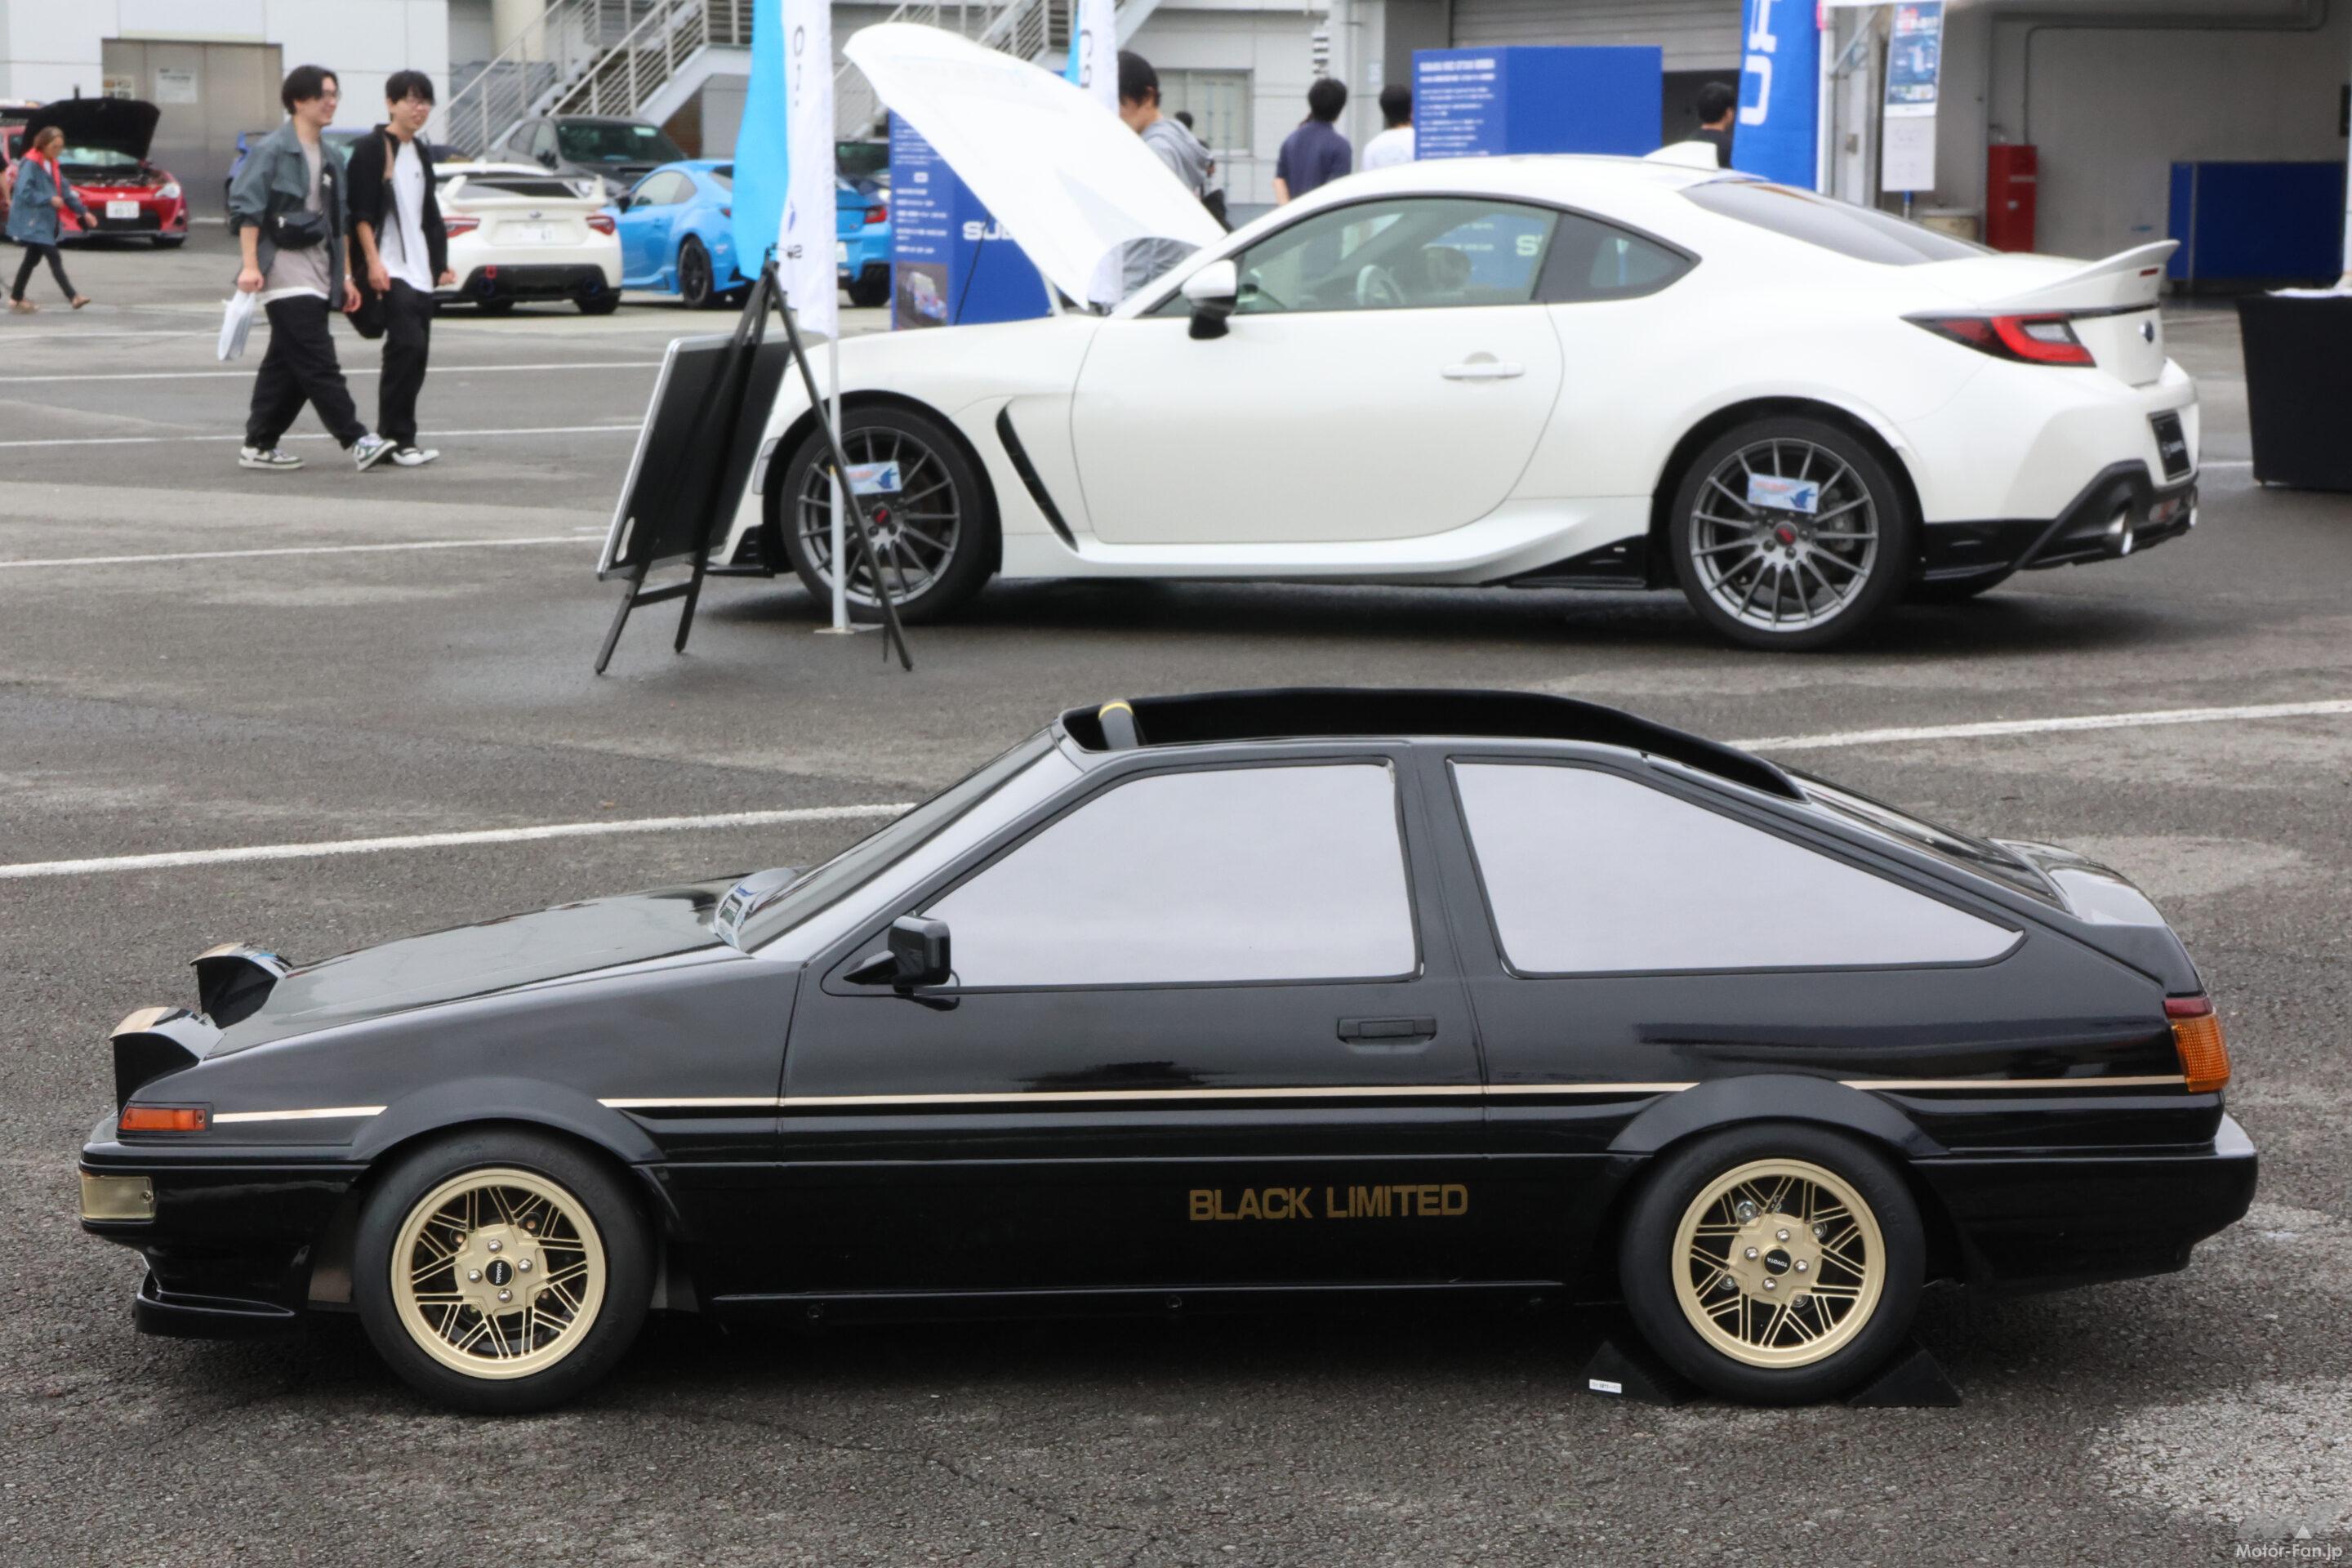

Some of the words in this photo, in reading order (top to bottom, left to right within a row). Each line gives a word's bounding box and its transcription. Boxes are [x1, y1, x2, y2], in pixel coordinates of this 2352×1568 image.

[1189, 1188, 1313, 1221] BLACK
[1326, 1184, 1468, 1218] LIMITED
[495, 1262, 503, 1285] TOYOTA
[1766, 1258, 1788, 1267] TOYOTA
